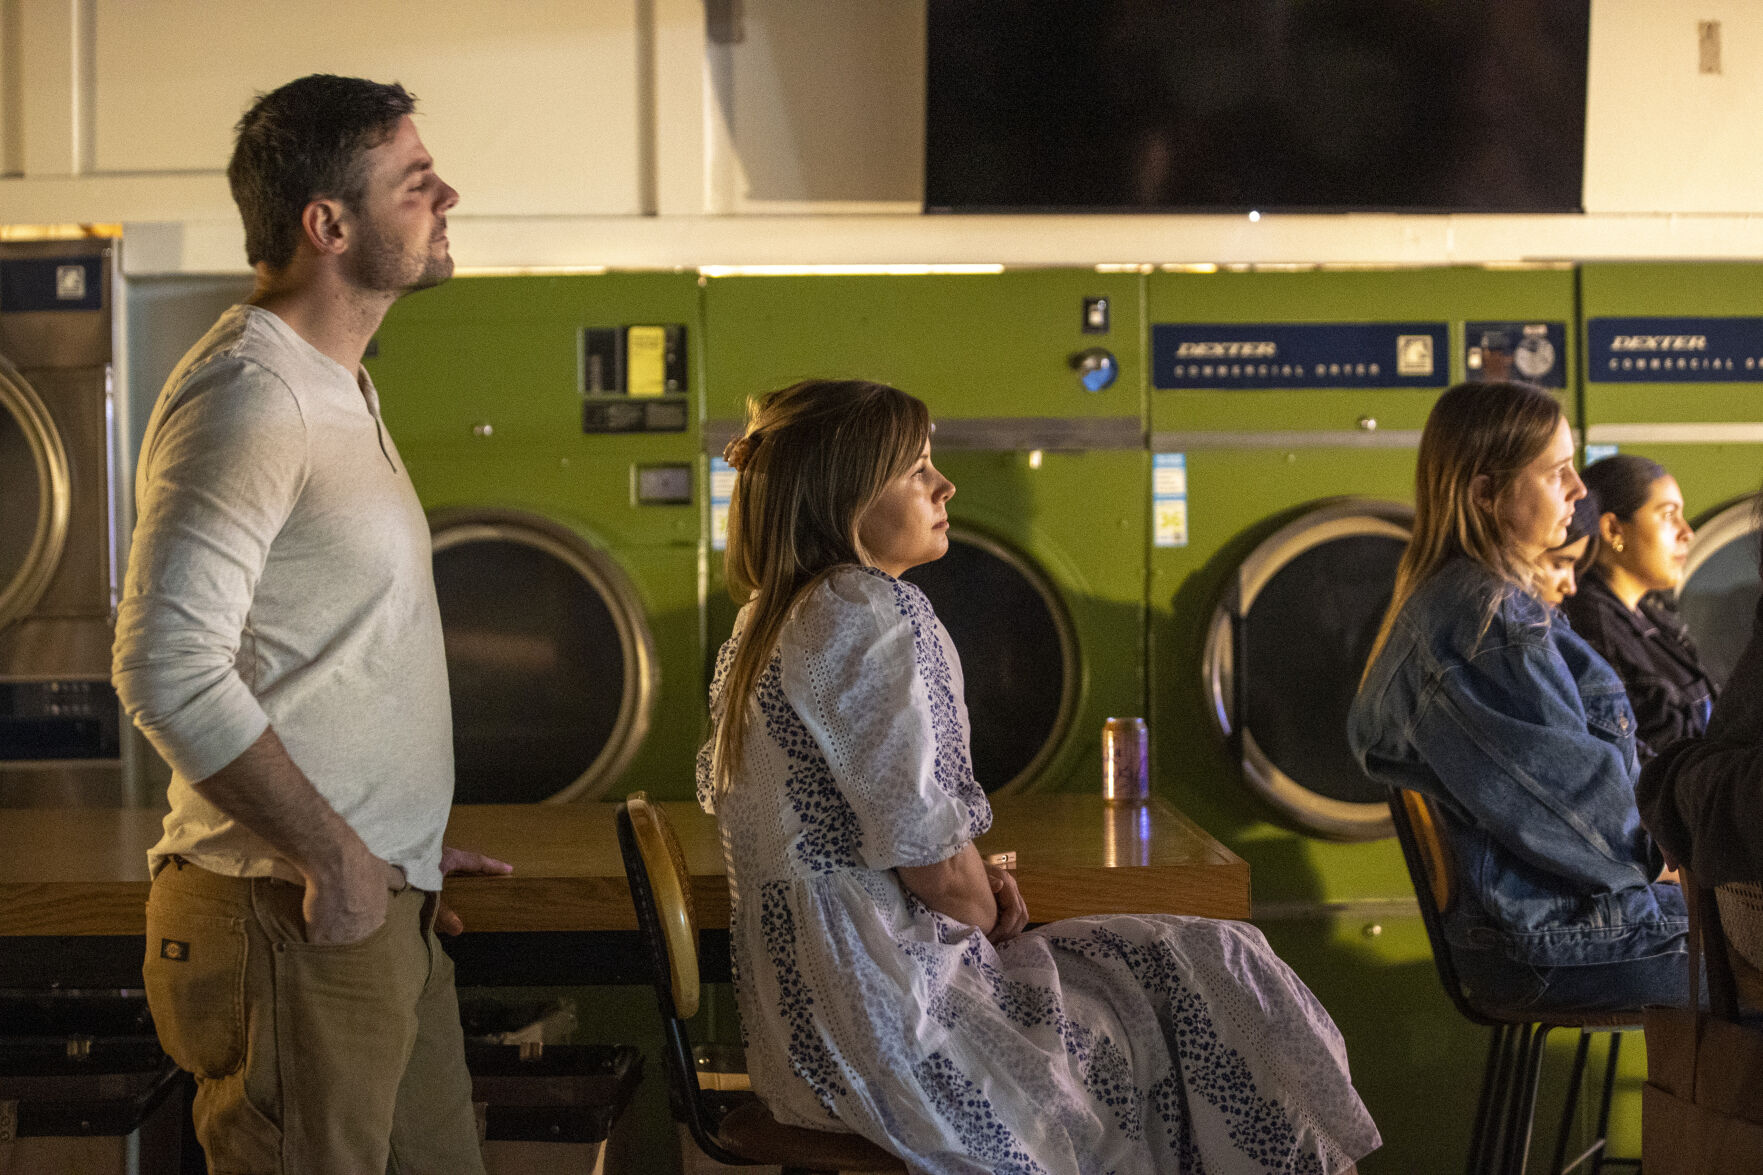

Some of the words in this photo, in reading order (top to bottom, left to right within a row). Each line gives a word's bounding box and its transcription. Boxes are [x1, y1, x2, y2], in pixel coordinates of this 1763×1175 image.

[1175, 341, 1276, 359] DEXTER
[1610, 334, 1707, 351] DEXTER
[1173, 364, 1304, 377] COMMERCIAL
[1608, 357, 1734, 371] COMMERCIAL
